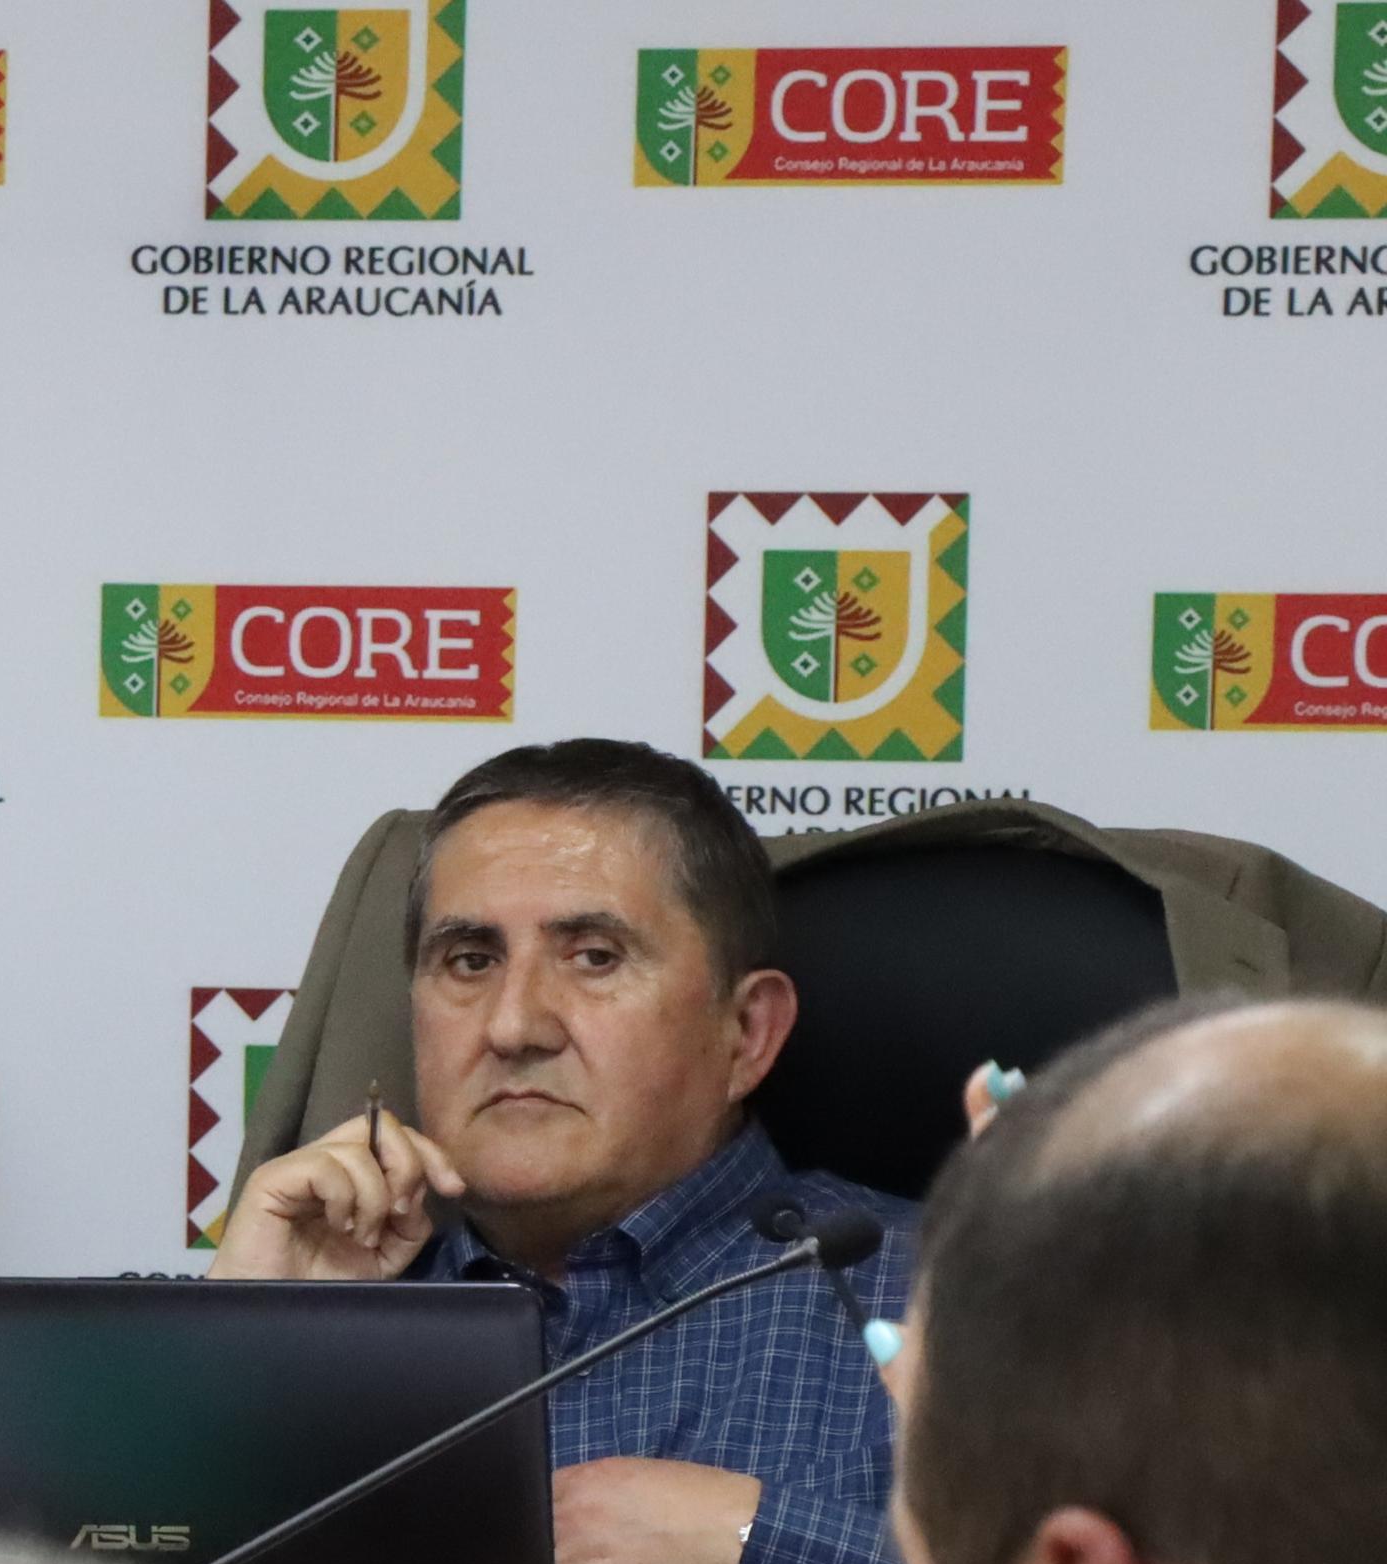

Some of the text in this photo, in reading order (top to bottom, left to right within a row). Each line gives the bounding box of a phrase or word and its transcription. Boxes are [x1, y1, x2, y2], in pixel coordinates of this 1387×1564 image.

[770, 69, 1031, 144] CORE
[773, 155, 835, 173] Consejo
[837, 156, 904, 174] Regional
[904, 157, 926, 172] de
[927, 157, 948, 172] La
[131, 244, 534, 276] GOBIERNO REGIONAL
[163, 279, 502, 317] DE LA ARAUCANÍA
[1222, 286, 1272, 317] DE
[1287, 287, 1334, 317] LA
[230, 605, 481, 680] CORE
[233, 689, 294, 708] Consejo
[295, 690, 359, 709] Regional
[360, 693, 381, 708] de
[383, 693, 401, 708] La
[1293, 700, 1358, 719] Consejo
[70, 1524, 190, 1552] ASUS
